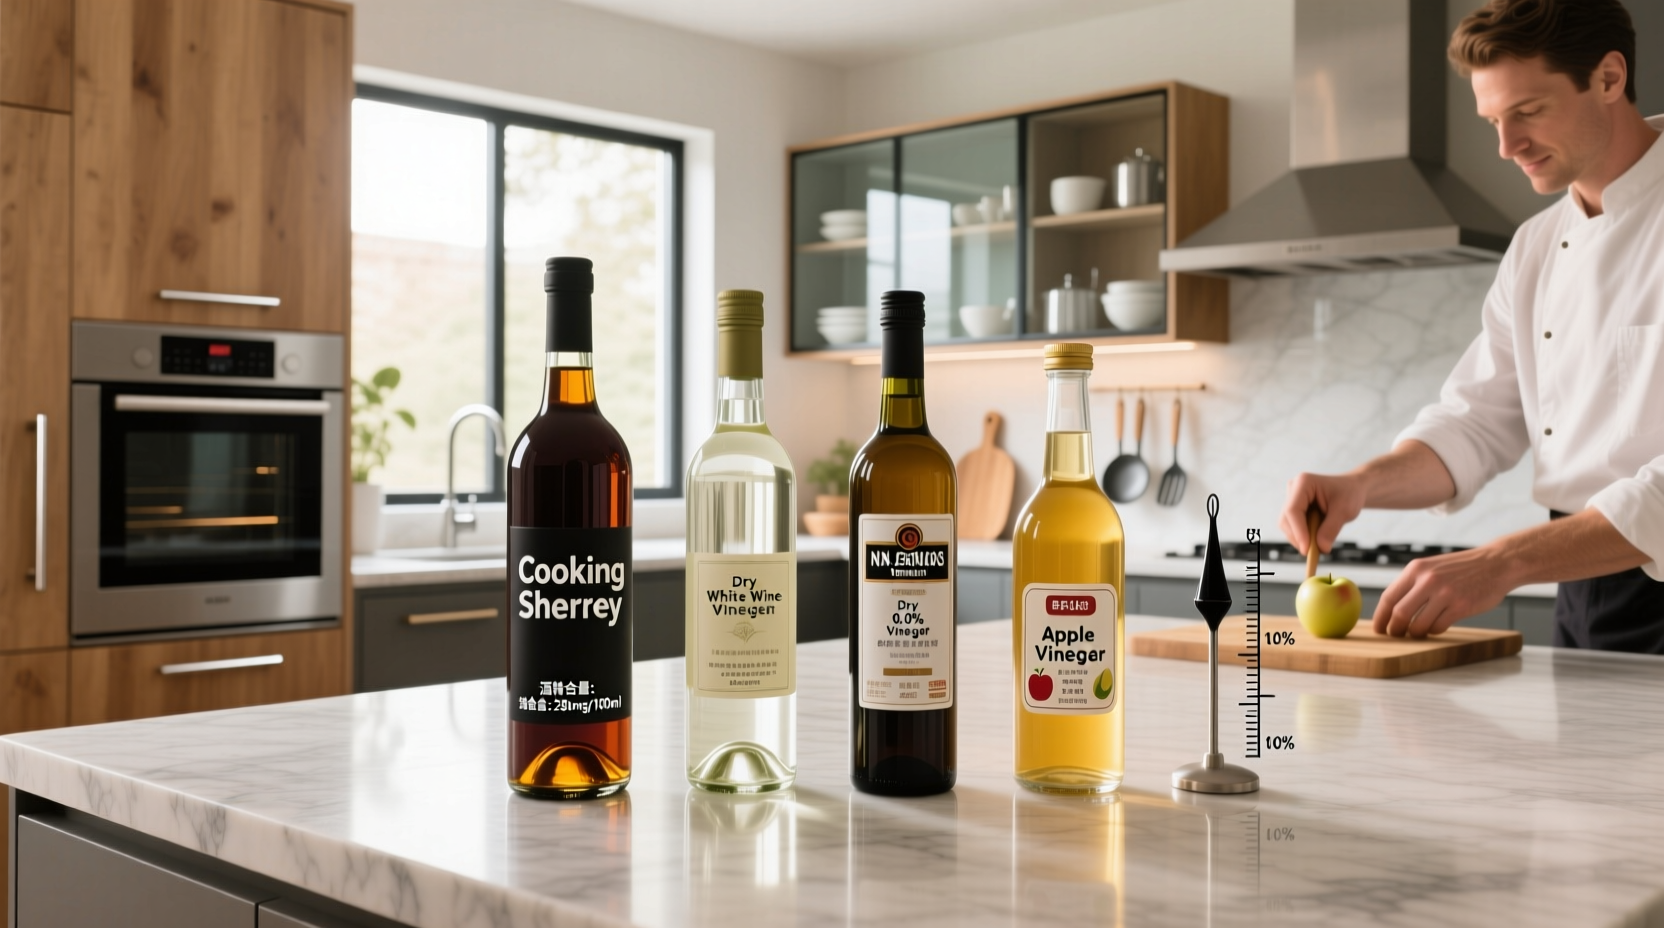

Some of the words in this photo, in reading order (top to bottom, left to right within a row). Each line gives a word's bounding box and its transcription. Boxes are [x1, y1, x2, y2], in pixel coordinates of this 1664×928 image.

[518, 555, 625, 591] Cooking
[732, 576, 757, 591] Dry
[706, 589, 746, 603] White
[750, 589, 782, 603] Wine
[518, 590, 623, 627] Sherrey
[897, 600, 919, 612] Dry
[892, 612, 924, 625] 0.0%
[1041, 625, 1095, 647] Apple
[1264, 631, 1296, 646] 10%
[1034, 645, 1106, 666] Vinegar
[1265, 735, 1295, 750] 10%
